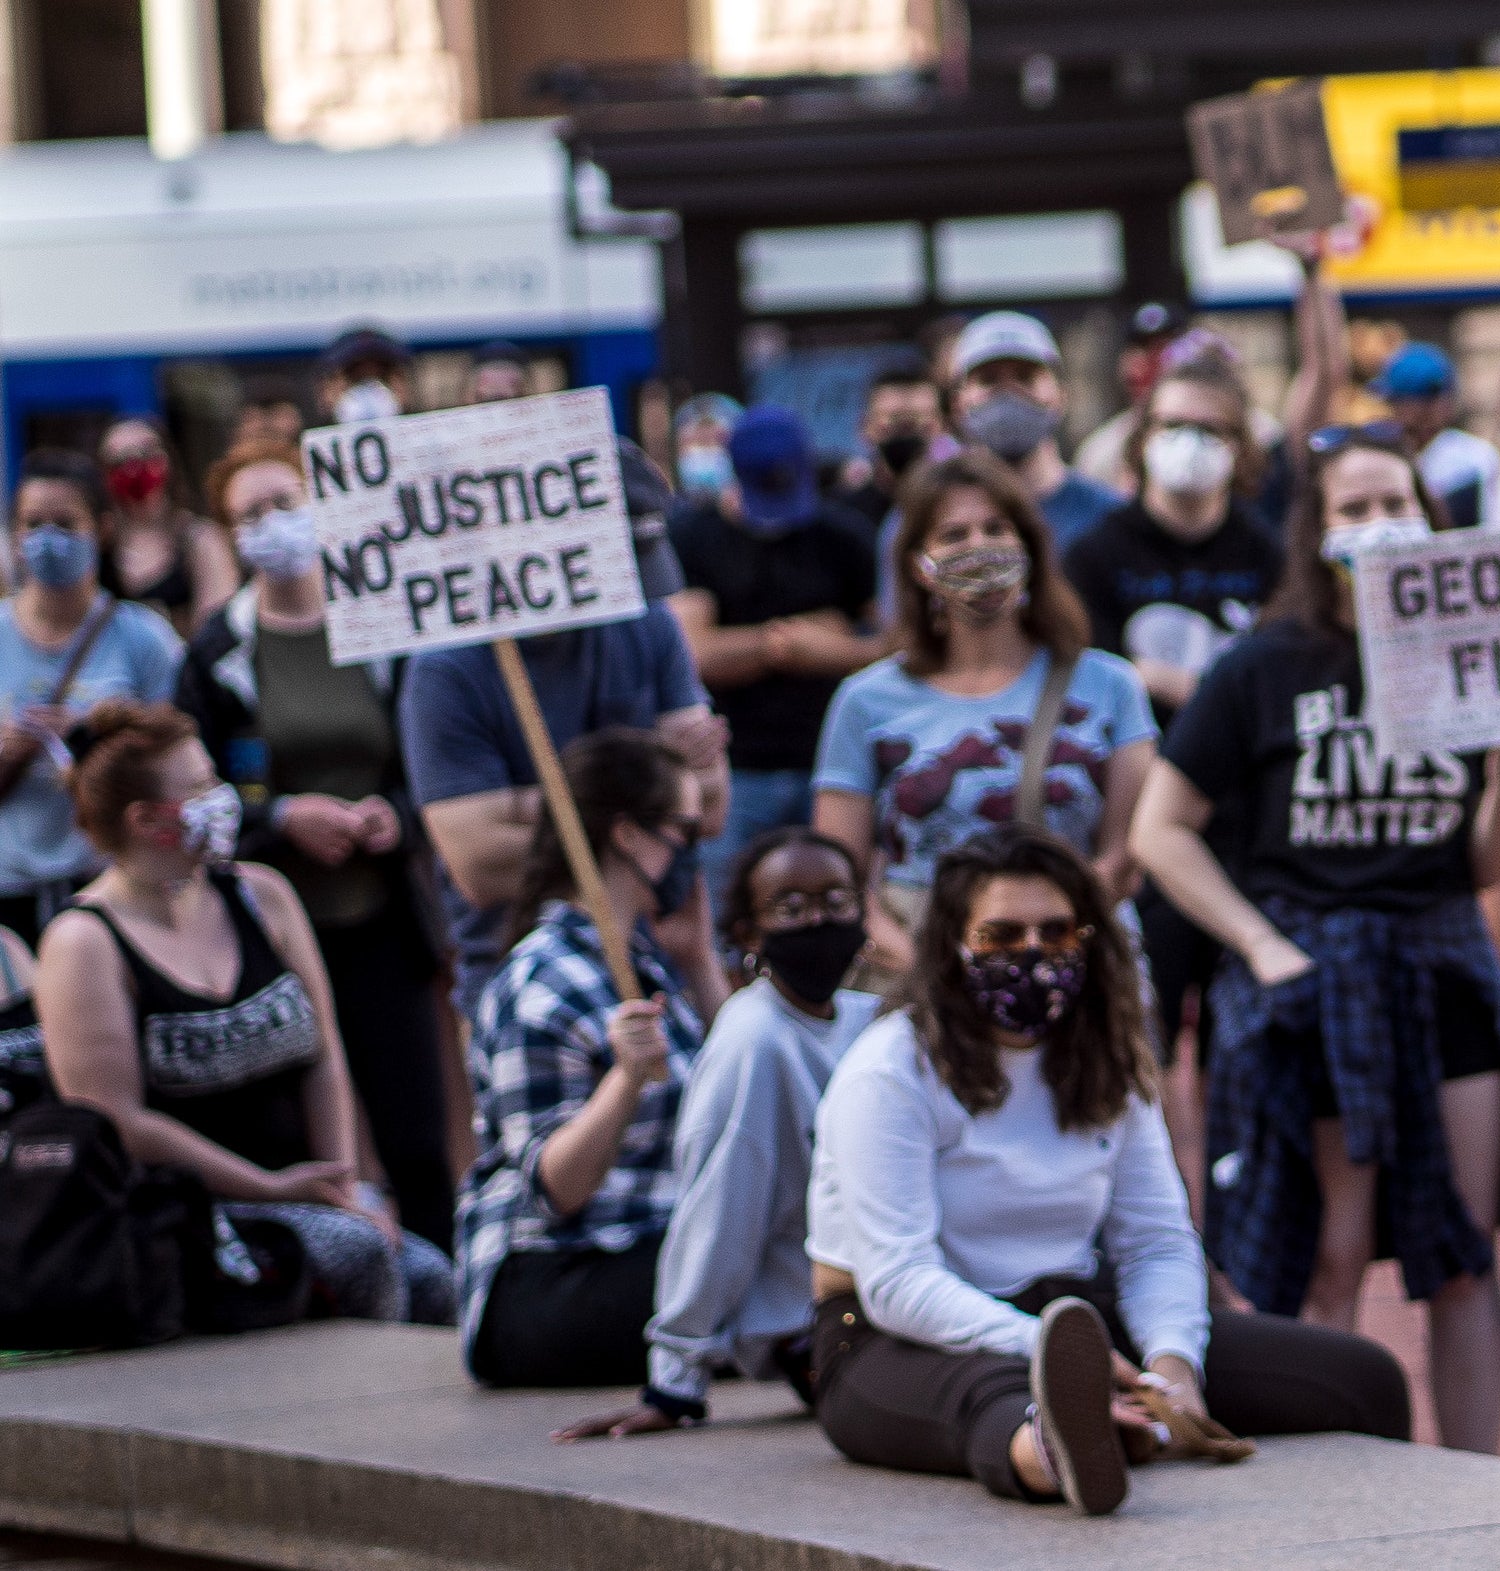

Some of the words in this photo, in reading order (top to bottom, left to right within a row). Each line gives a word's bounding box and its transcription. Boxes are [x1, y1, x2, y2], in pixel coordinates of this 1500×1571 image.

[309, 429, 390, 500] NO
[381, 452, 609, 542] JUSTICE
[320, 536, 393, 602] NO
[404, 543, 600, 633] PEACE
[1291, 734, 1469, 798] LIVES
